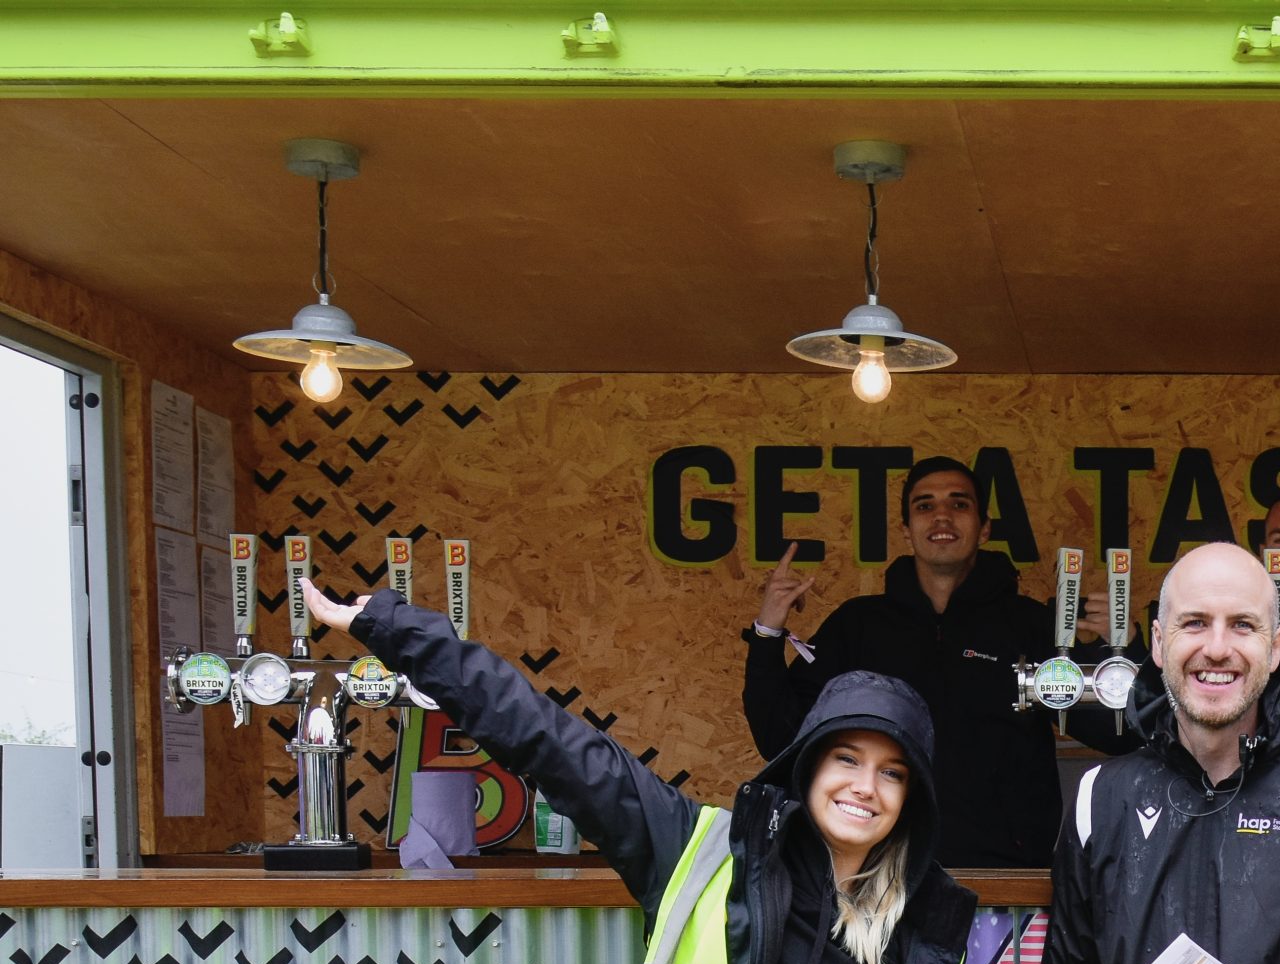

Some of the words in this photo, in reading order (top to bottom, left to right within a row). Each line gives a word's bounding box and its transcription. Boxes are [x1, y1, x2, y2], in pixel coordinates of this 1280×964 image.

[652, 444, 914, 563] GET
[233, 537, 251, 560] B
[289, 540, 307, 562] B
[391, 541, 409, 564] B
[447, 543, 466, 566] B
[1065, 551, 1081, 574] B
[1112, 551, 1129, 574] B
[236, 565, 247, 617] BRIXTON
[452, 571, 464, 623] BRIXTON
[1064, 579, 1076, 630] BRIXTON
[1115, 579, 1125, 630] BRIXTON
[186, 679, 224, 688] BRIXTON
[353, 683, 391, 691] BRIXTON
[1040, 684, 1077, 692] BRIXTON
[1237, 812, 1271, 834] hap
